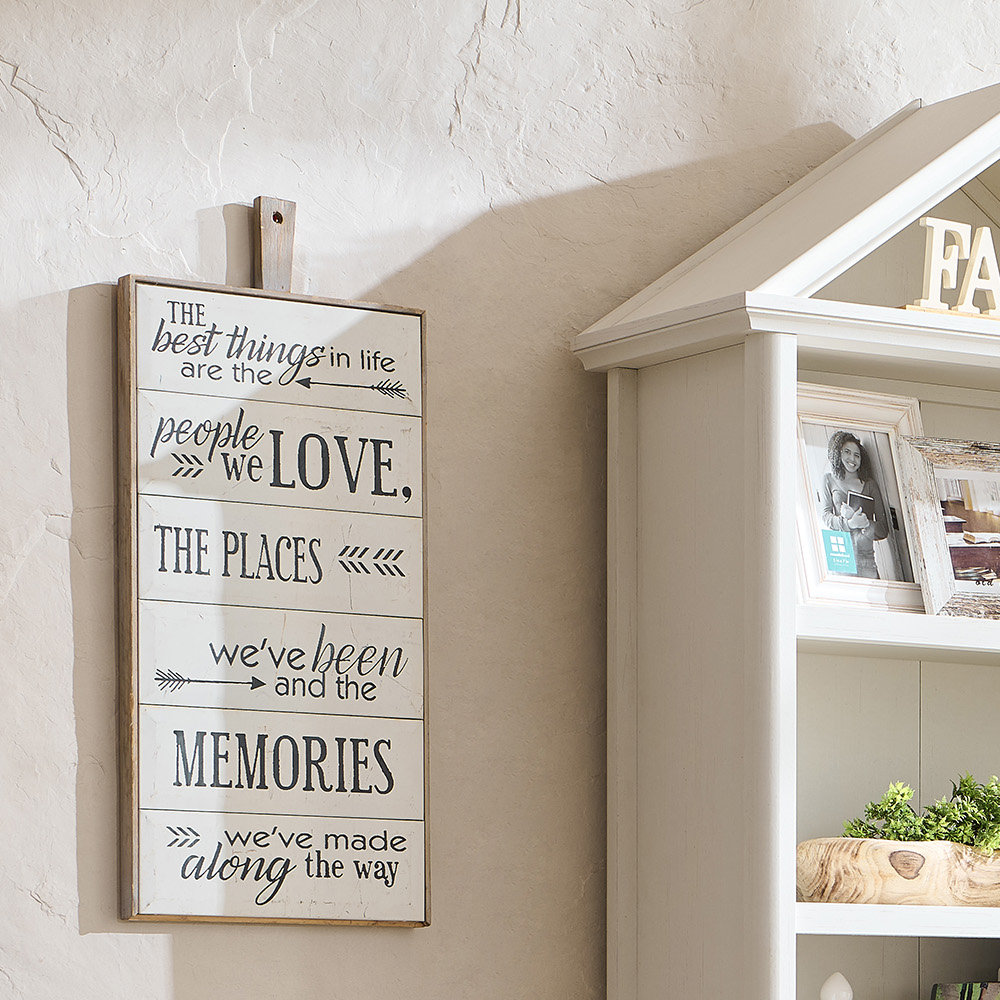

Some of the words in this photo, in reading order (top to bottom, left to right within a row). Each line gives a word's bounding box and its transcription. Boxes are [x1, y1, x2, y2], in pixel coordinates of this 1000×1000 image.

[167, 301, 206, 327] THE
[151, 317, 223, 358] best
[226, 325, 326, 387] things
[330, 347, 350, 368] in
[360, 350, 396, 372] life
[181, 361, 223, 380] are
[232, 363, 272, 385] the
[150, 407, 264, 463] people
[220, 452, 263, 482] we
[269, 430, 412, 503] LOVE,
[154, 524, 210, 575] THE
[222, 530, 323, 584] PLACES
[209, 638, 305, 670] we've
[312, 623, 408, 678] been
[275, 673, 326, 698] and
[336, 675, 377, 701] the
[173, 730, 394, 794] MEMORIES
[224, 827, 313, 849] we've
[324, 830, 407, 853] made
[181, 841, 297, 905] along
[305, 850, 344, 878] the
[353, 858, 399, 887] way
